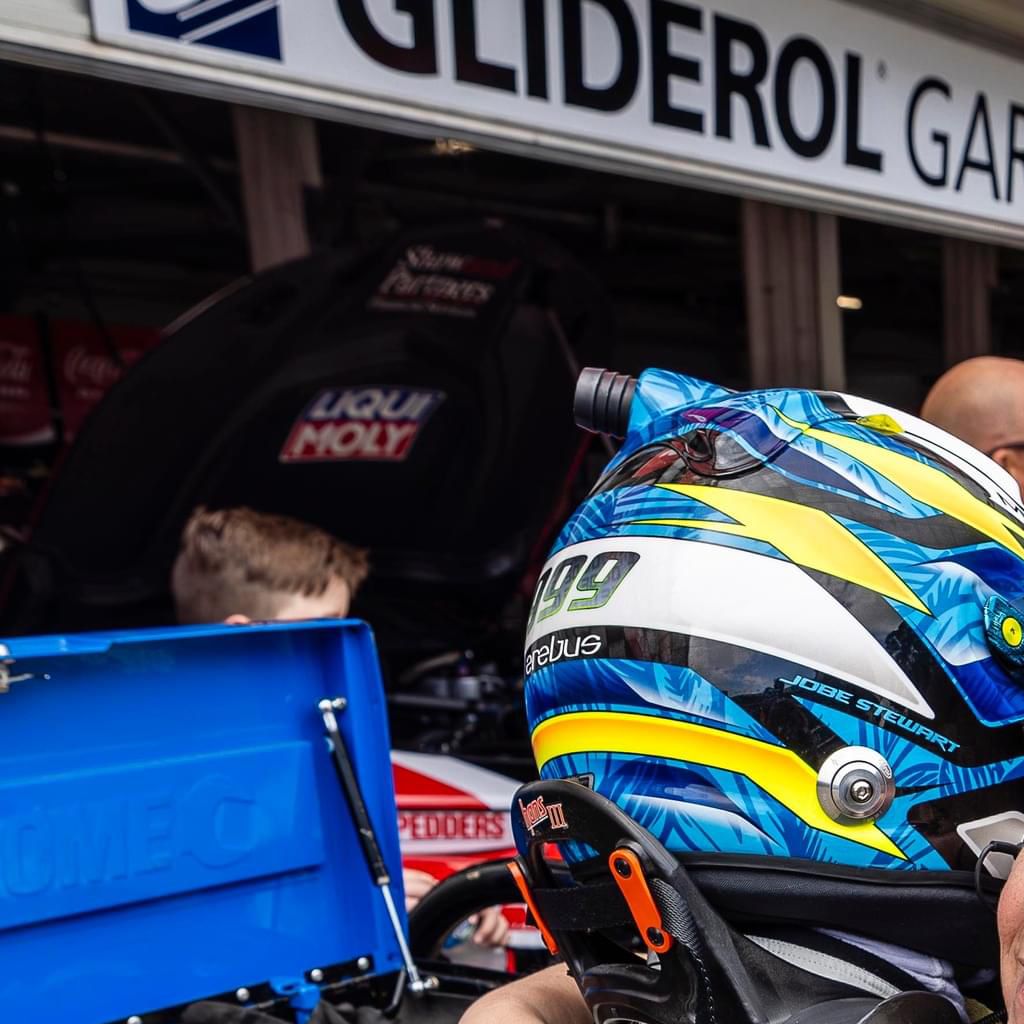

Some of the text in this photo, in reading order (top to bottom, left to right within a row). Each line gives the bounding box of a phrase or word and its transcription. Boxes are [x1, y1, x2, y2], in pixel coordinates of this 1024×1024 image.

[334, 0, 884, 173] GLIDEROL
[308, 389, 434, 420] LIQUI
[291, 423, 416, 459] MOLY
[778, 674, 961, 753] JOBE STEWART
[398, 812, 505, 839] PEDDERS
